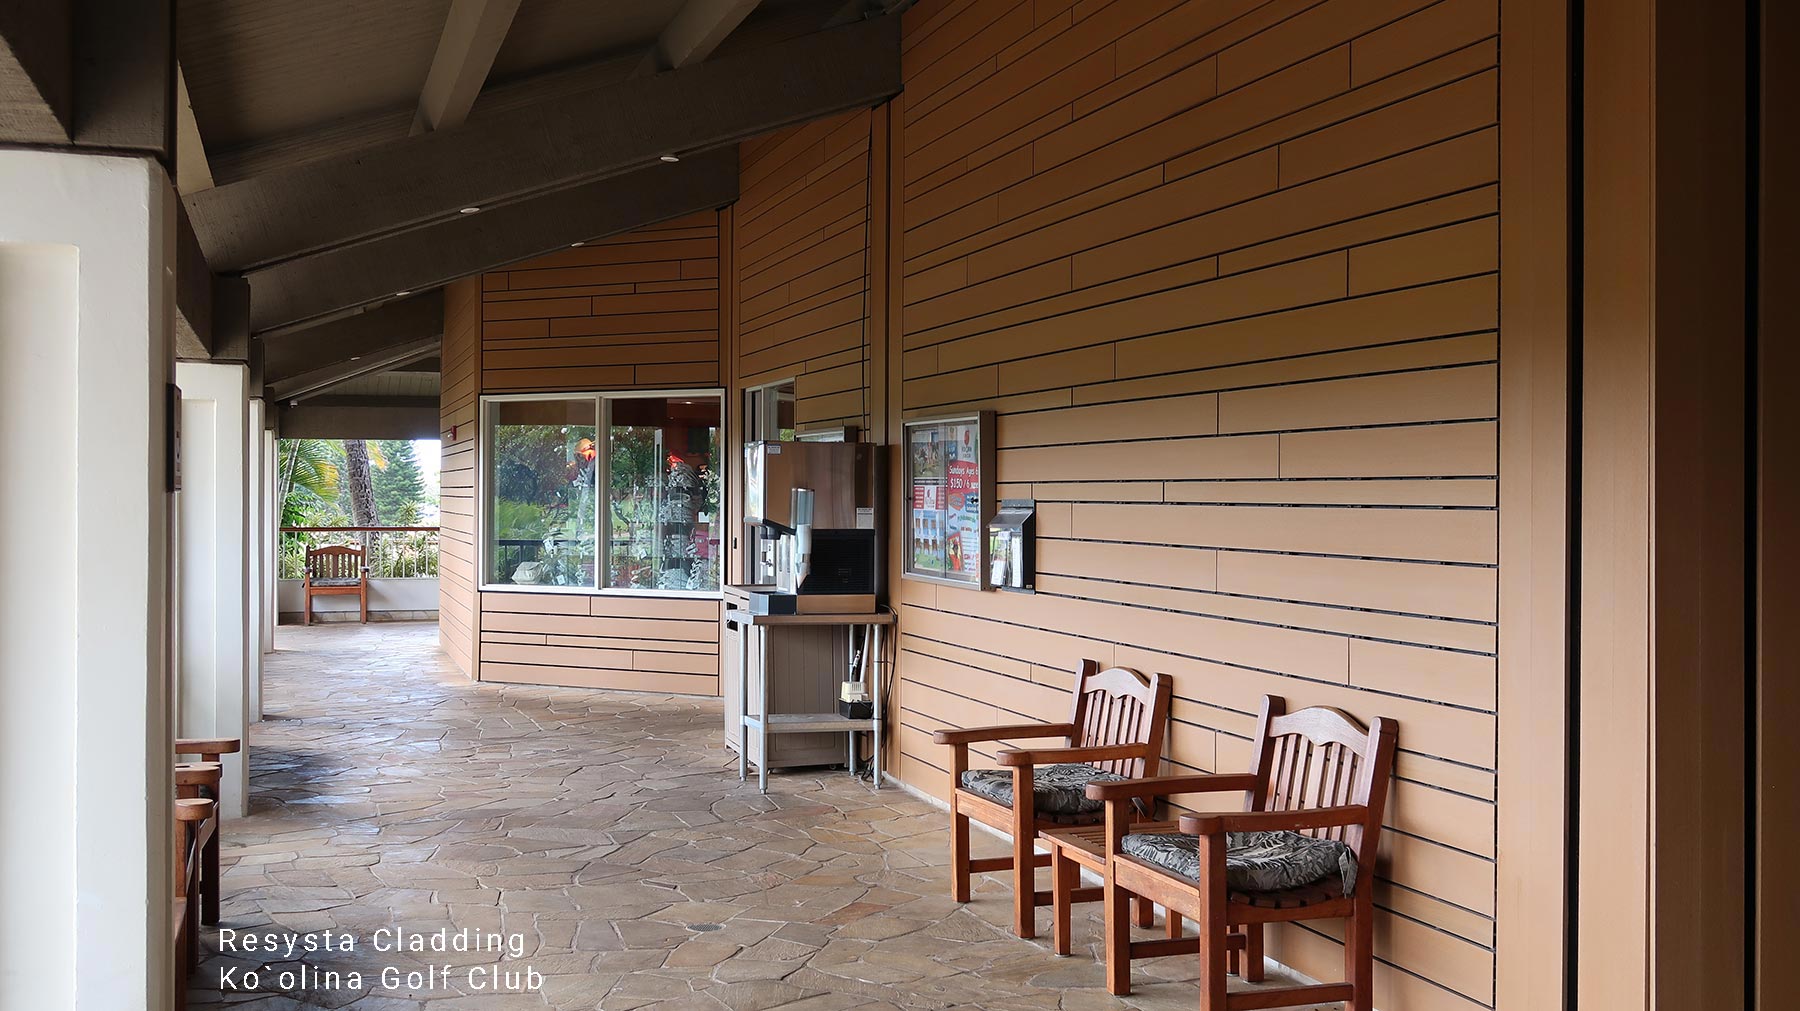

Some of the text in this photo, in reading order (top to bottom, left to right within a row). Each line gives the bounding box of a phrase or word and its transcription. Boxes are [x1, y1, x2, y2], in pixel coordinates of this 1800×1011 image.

[949, 465, 965, 477] Sundays
[966, 467, 974, 477] Ages
[950, 478, 963, 488] $150
